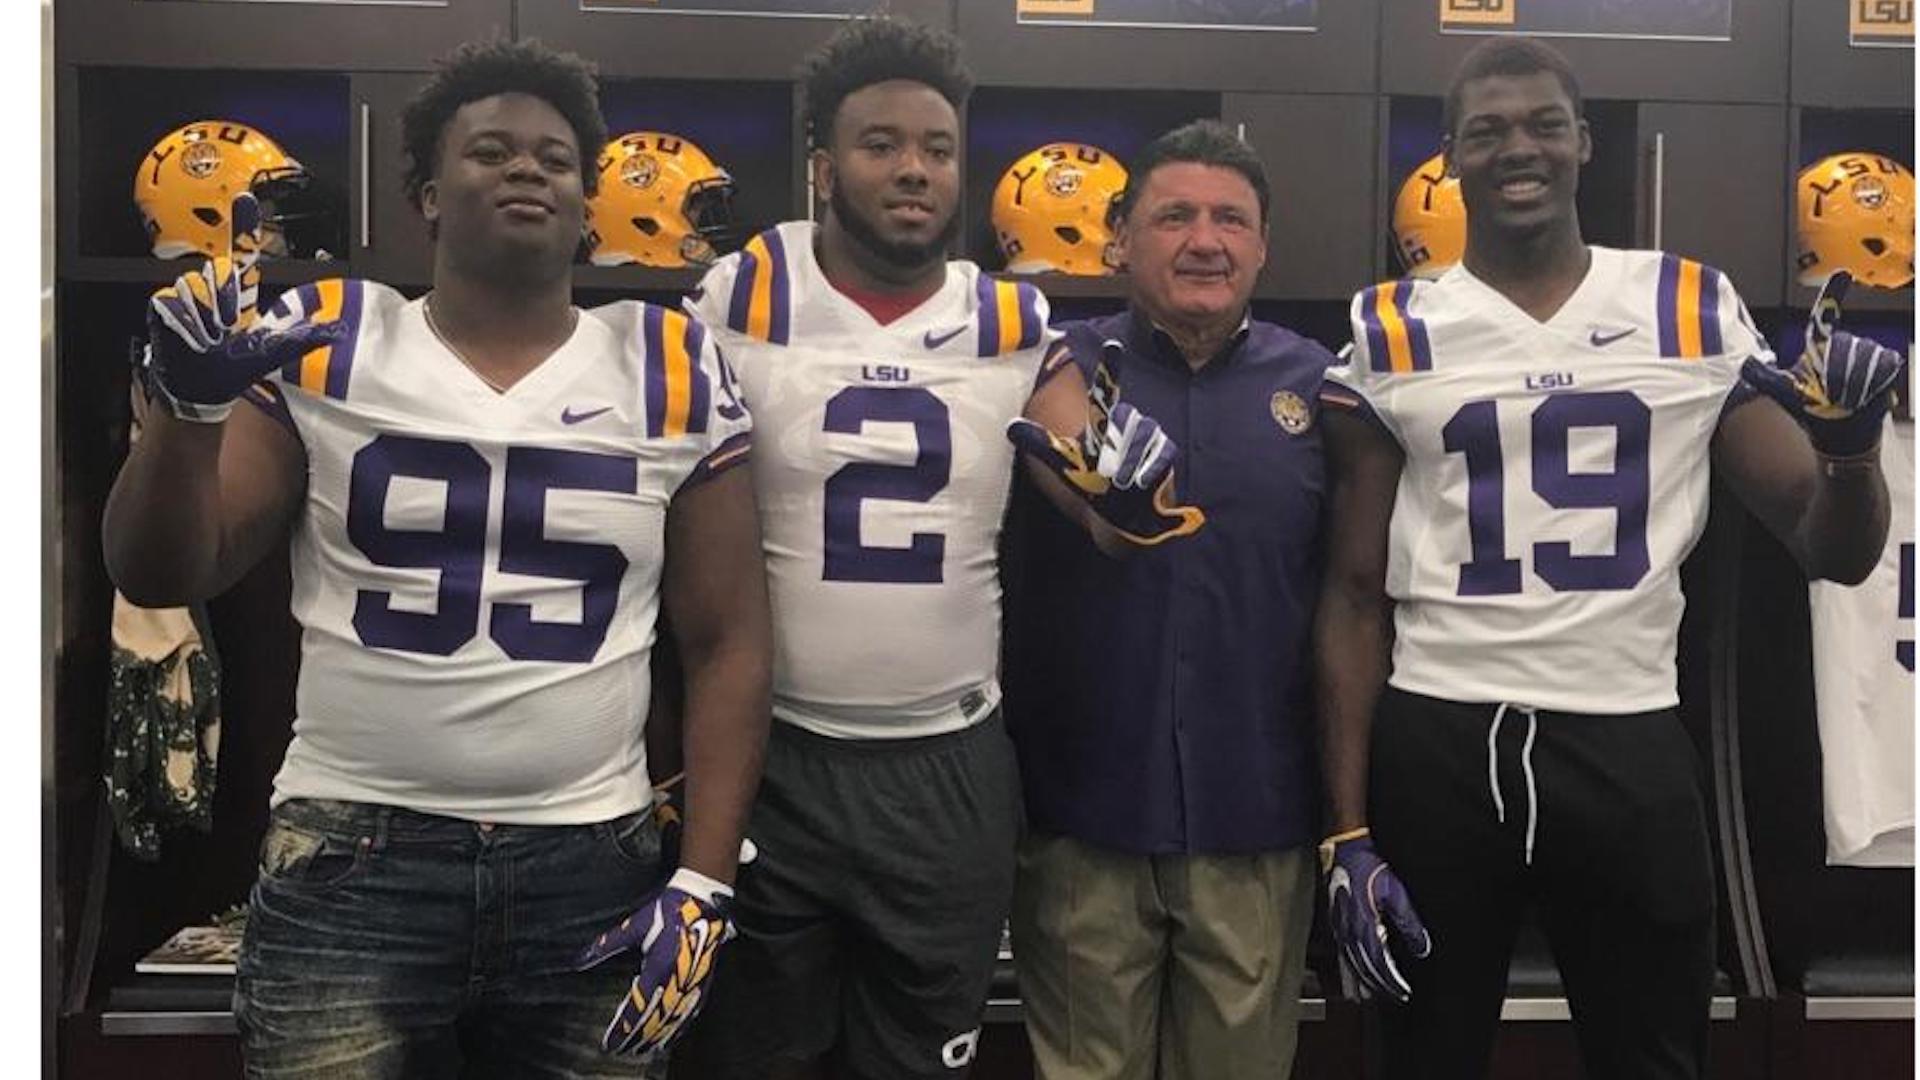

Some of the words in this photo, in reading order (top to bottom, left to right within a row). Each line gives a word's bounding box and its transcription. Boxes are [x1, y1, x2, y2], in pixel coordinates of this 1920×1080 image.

[152, 126, 248, 186] LSU
[1012, 148, 1100, 206] LSU
[1809, 158, 1899, 217] LSU
[862, 365, 910, 381] LSU
[1525, 373, 1573, 390] LSU
[821, 385, 953, 584] 2
[1442, 391, 1653, 596] 19
[346, 434, 639, 663] 95
